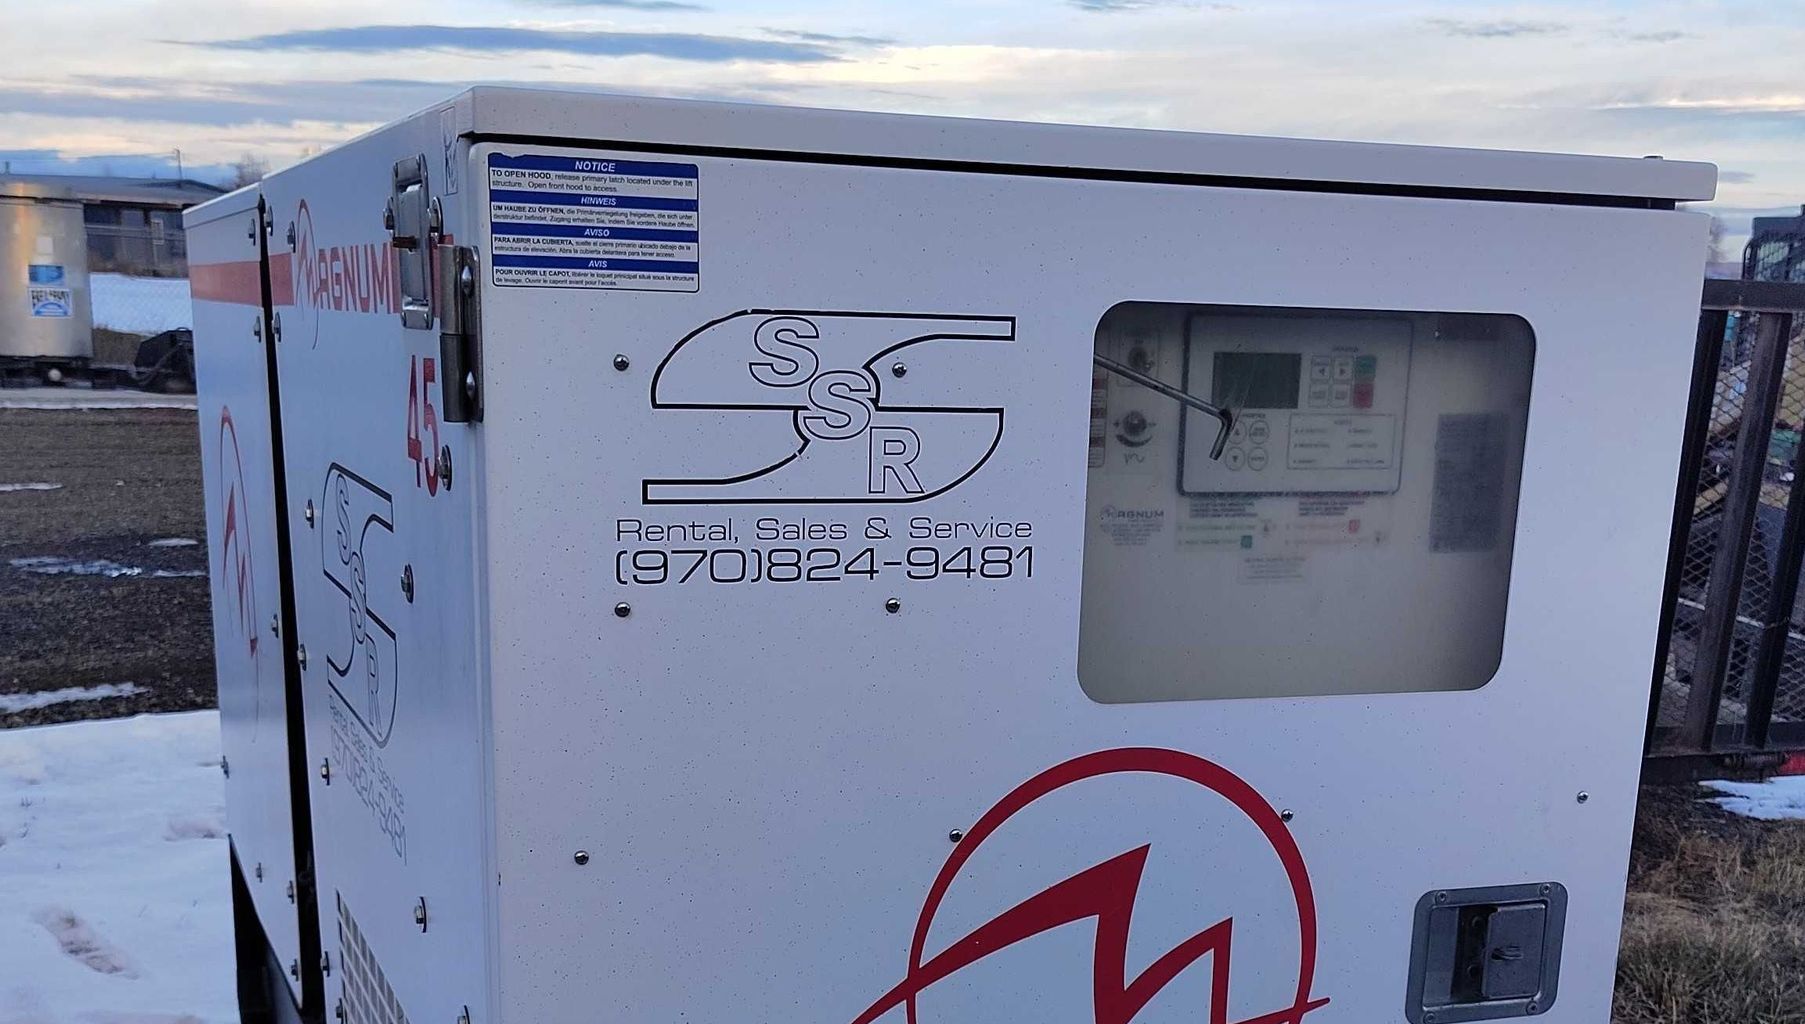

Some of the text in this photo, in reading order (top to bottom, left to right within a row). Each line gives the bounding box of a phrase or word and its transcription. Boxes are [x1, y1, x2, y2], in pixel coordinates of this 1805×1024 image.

[575, 160, 616, 172] NOTICE
[492, 169, 502, 177] TO
[504, 170, 526, 178] OPEN
[582, 175, 607, 184] primary
[627, 177, 651, 185] located
[652, 178, 672, 186] under
[528, 181, 547, 189] Open
[549, 182, 564, 190] front
[566, 183, 583, 191] hood
[580, 197, 616, 206] HINWEIS
[584, 229, 610, 237] AVISO
[588, 260, 608, 268] AVIS
[408, 355, 439, 497] 45
[615, 516, 1033, 543] Rental, Sales & Service
[615, 546, 1034, 585] (970)824-9481
